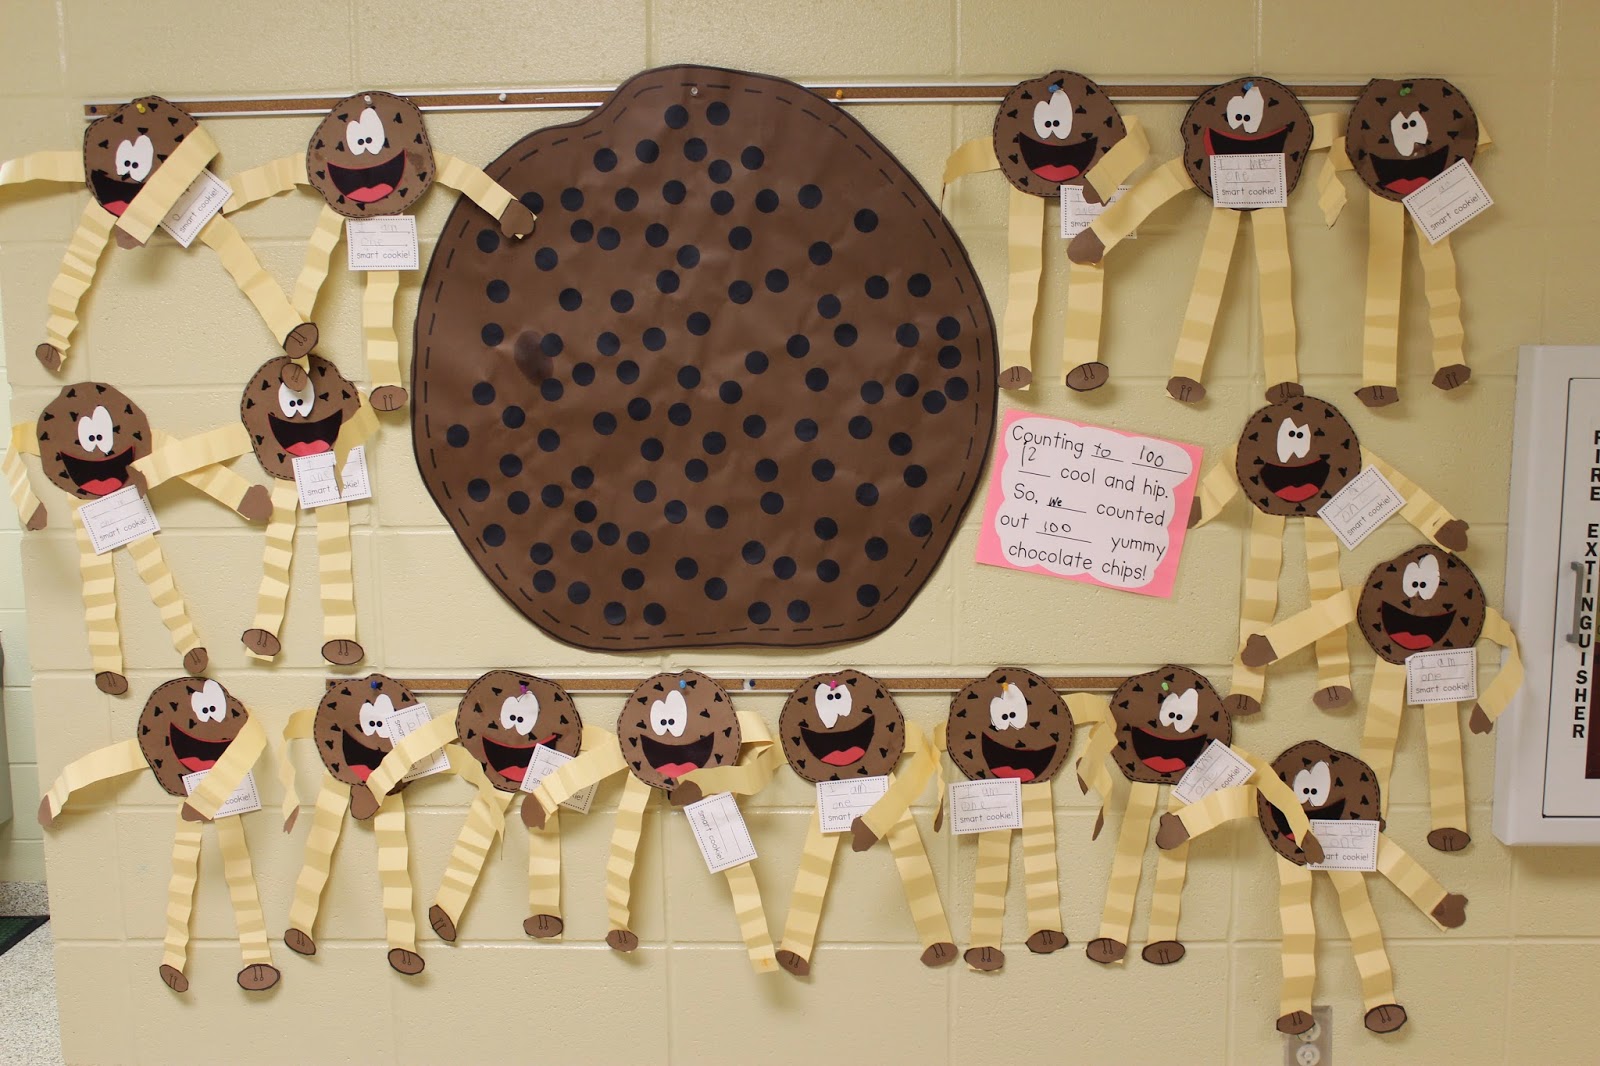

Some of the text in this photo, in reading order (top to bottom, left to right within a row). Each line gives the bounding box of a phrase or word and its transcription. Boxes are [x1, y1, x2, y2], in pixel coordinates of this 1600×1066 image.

[1221, 187, 1244, 196] smart
[180, 212, 197, 233] smart
[1070, 220, 1092, 228] smar
[1430, 212, 1452, 231] smart
[356, 251, 379, 259] smart
[1012, 425, 1164, 468] Counting to 100
[307, 480, 360, 496] smart cokie!
[1060, 467, 1096, 484] cool
[1104, 475, 1136, 492] and
[1142, 478, 1169, 502] hip.
[1013, 483, 1039, 505] So,
[1096, 503, 1166, 527] counted
[99, 528, 120, 541] smart
[1347, 515, 1367, 536] smart
[1000, 513, 1166, 562] out 100 yummy
[1008, 541, 1147, 582] chocolate chips!
[1572, 523, 1598, 739] EXTINGUISHER
[1416, 685, 1439, 694] smart
[394, 719, 406, 738] smar
[698, 810, 712, 832] smart
[828, 813, 851, 822] smart
[960, 815, 983, 824] smart
[1325, 852, 1339, 860] art
